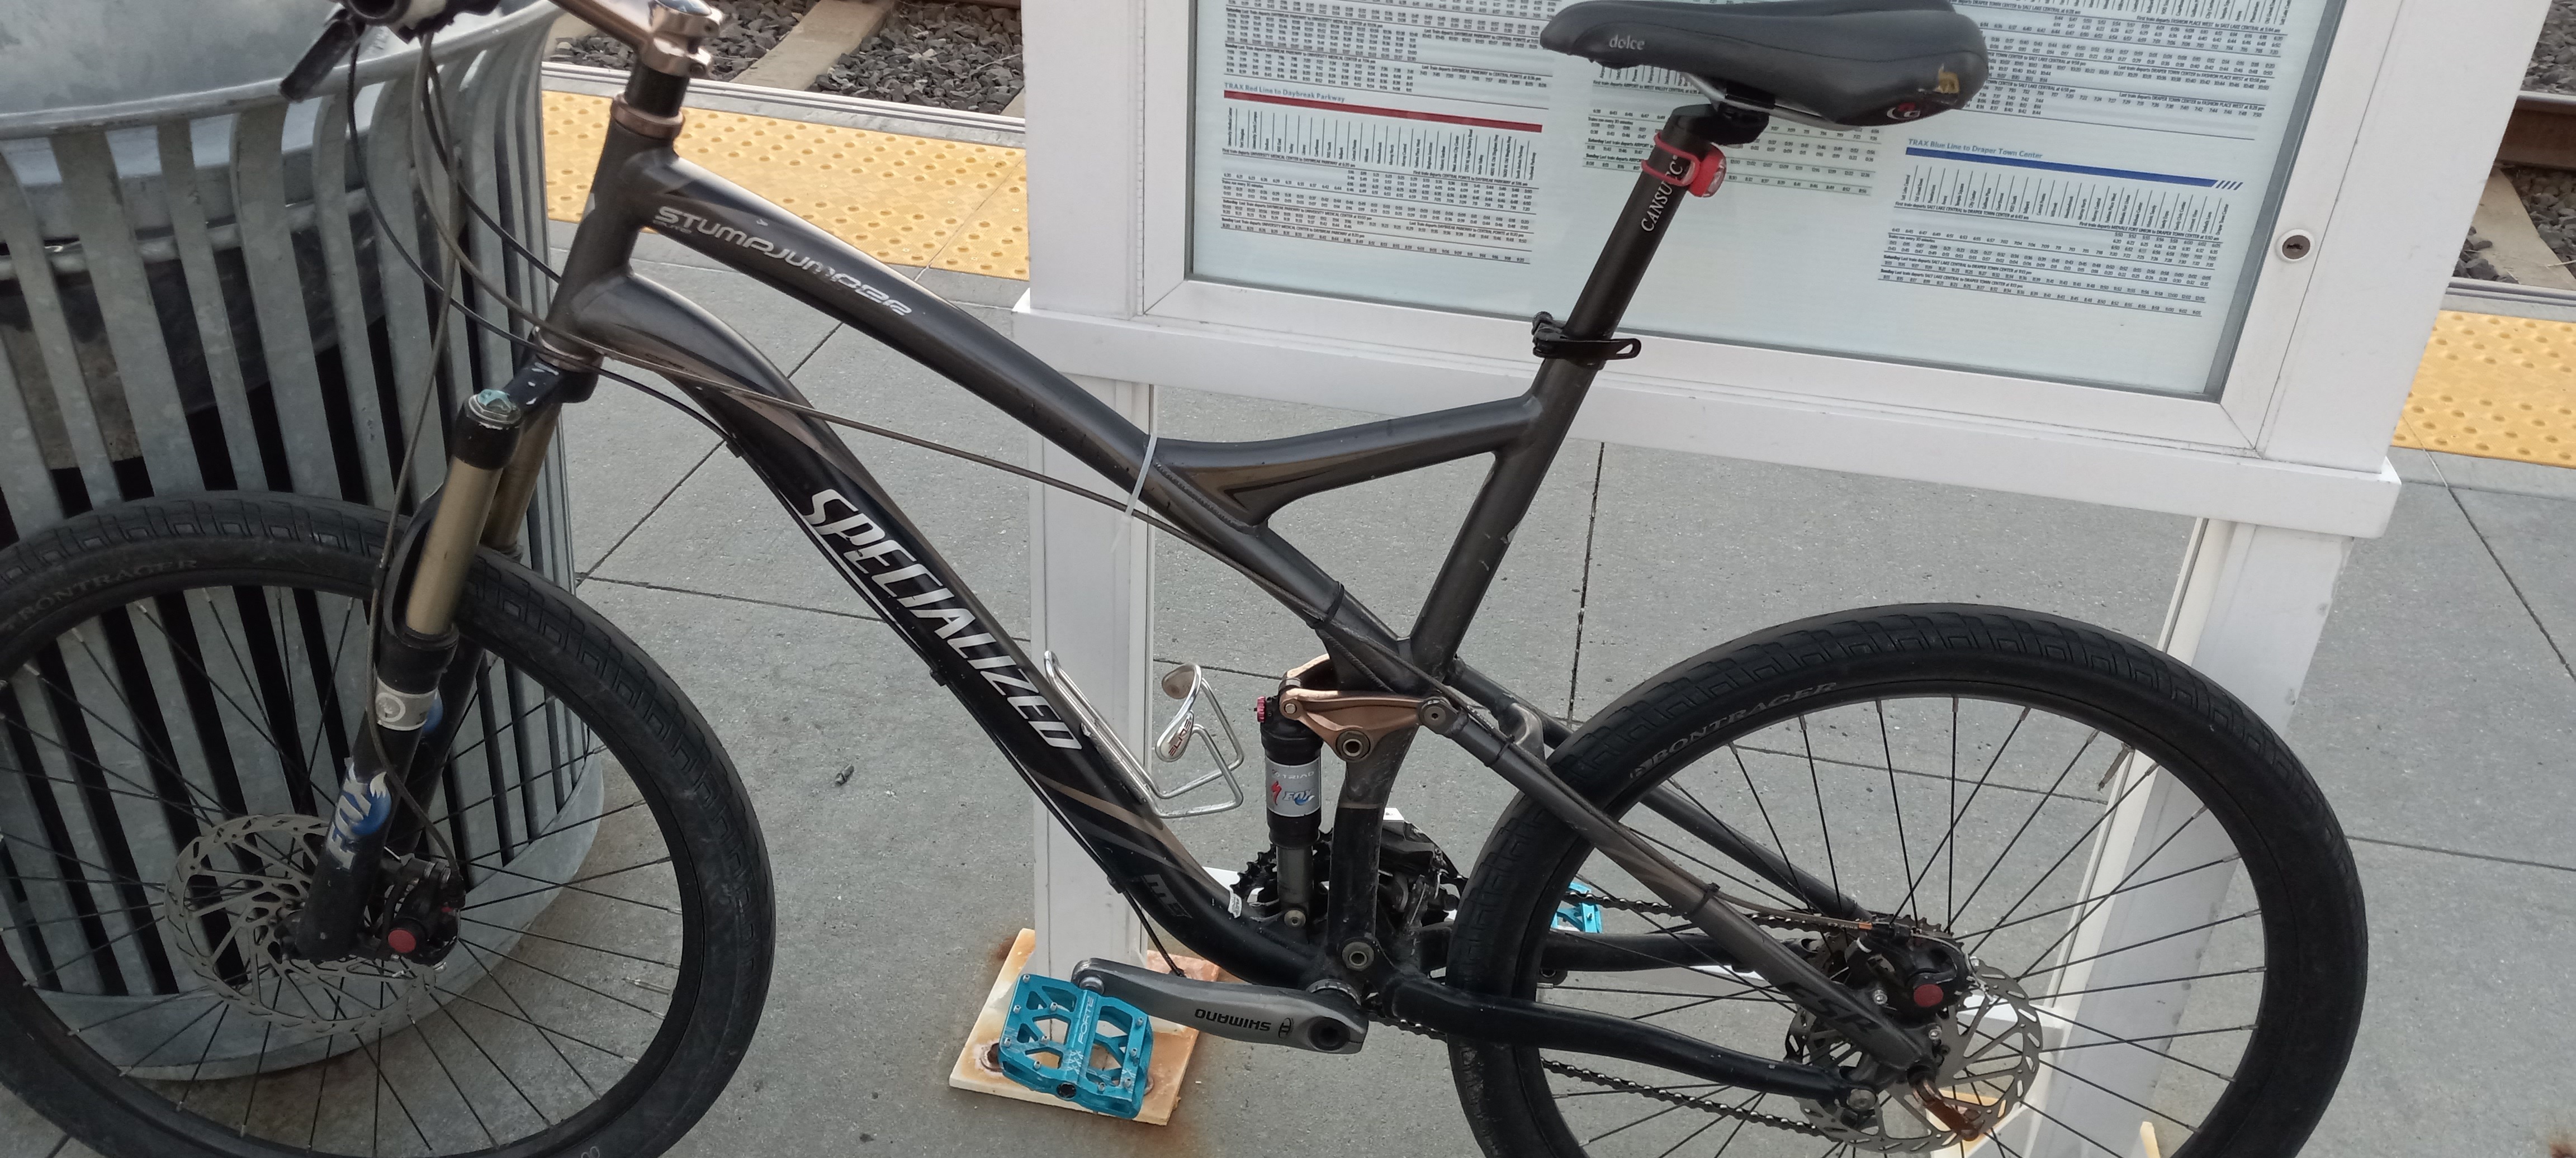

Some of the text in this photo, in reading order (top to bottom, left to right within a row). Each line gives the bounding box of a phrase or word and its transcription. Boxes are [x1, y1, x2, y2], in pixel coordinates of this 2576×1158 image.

[1609, 34, 1645, 50] dolce
[1283, 89, 1314, 98] Daybreak
[1317, 93, 1344, 102] Parkway
[1641, 162, 1683, 231] CANSUC
[653, 206, 912, 316] STUMPJUMPER
[803, 488, 1083, 750] SPECIALIZED
[1649, 682, 1837, 763] BONTRAGER
[1077, 996, 1095, 1045] FORTE
[1195, 1008, 1271, 1032] SHIMANO
